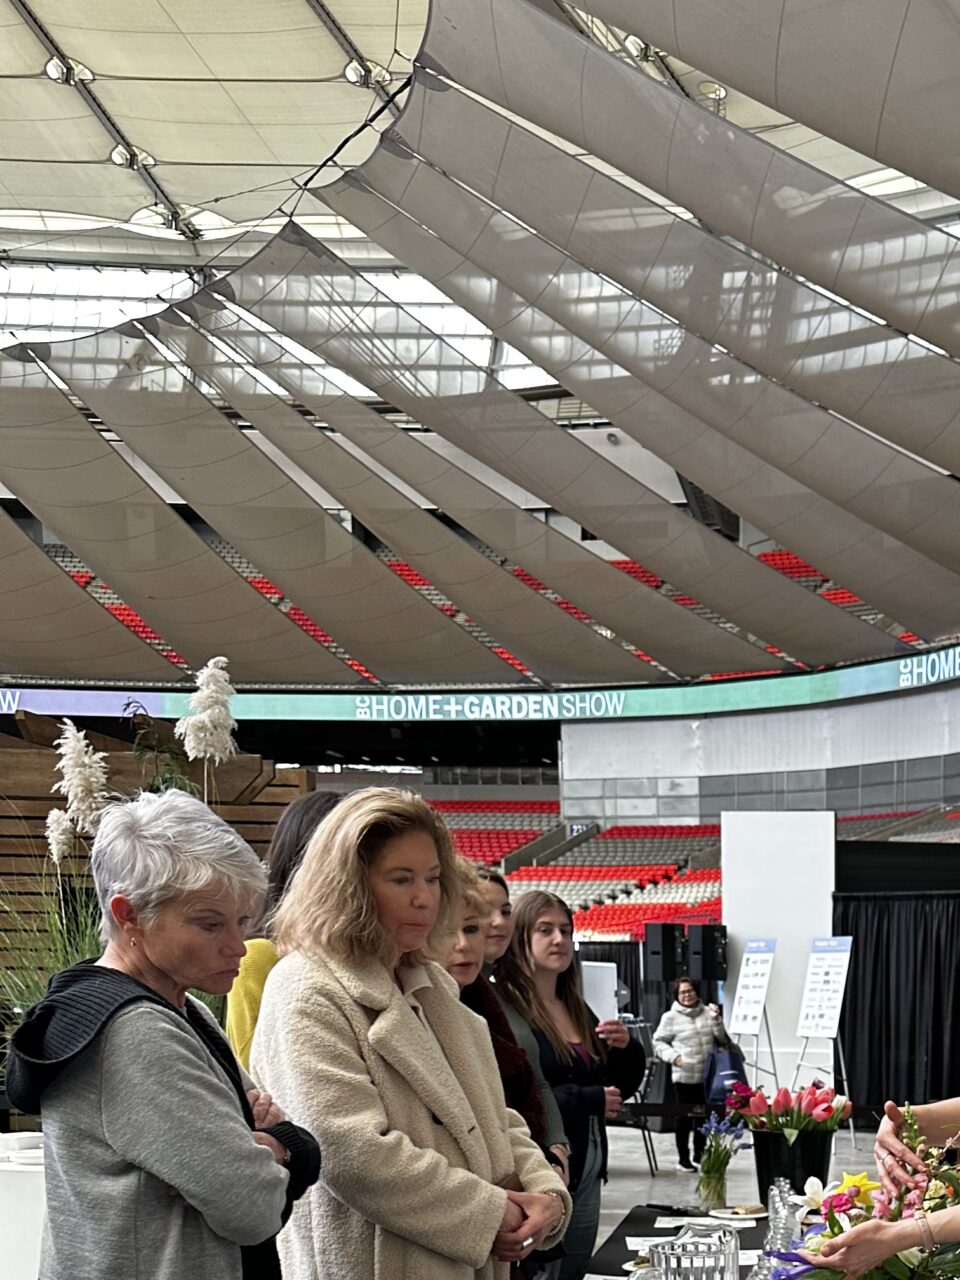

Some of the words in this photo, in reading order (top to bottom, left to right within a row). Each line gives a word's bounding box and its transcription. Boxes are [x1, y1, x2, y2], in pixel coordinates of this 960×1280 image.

[900, 658, 912, 686] BC
[356, 696, 370, 719] BC
[562, 692, 625, 718] SHOW
